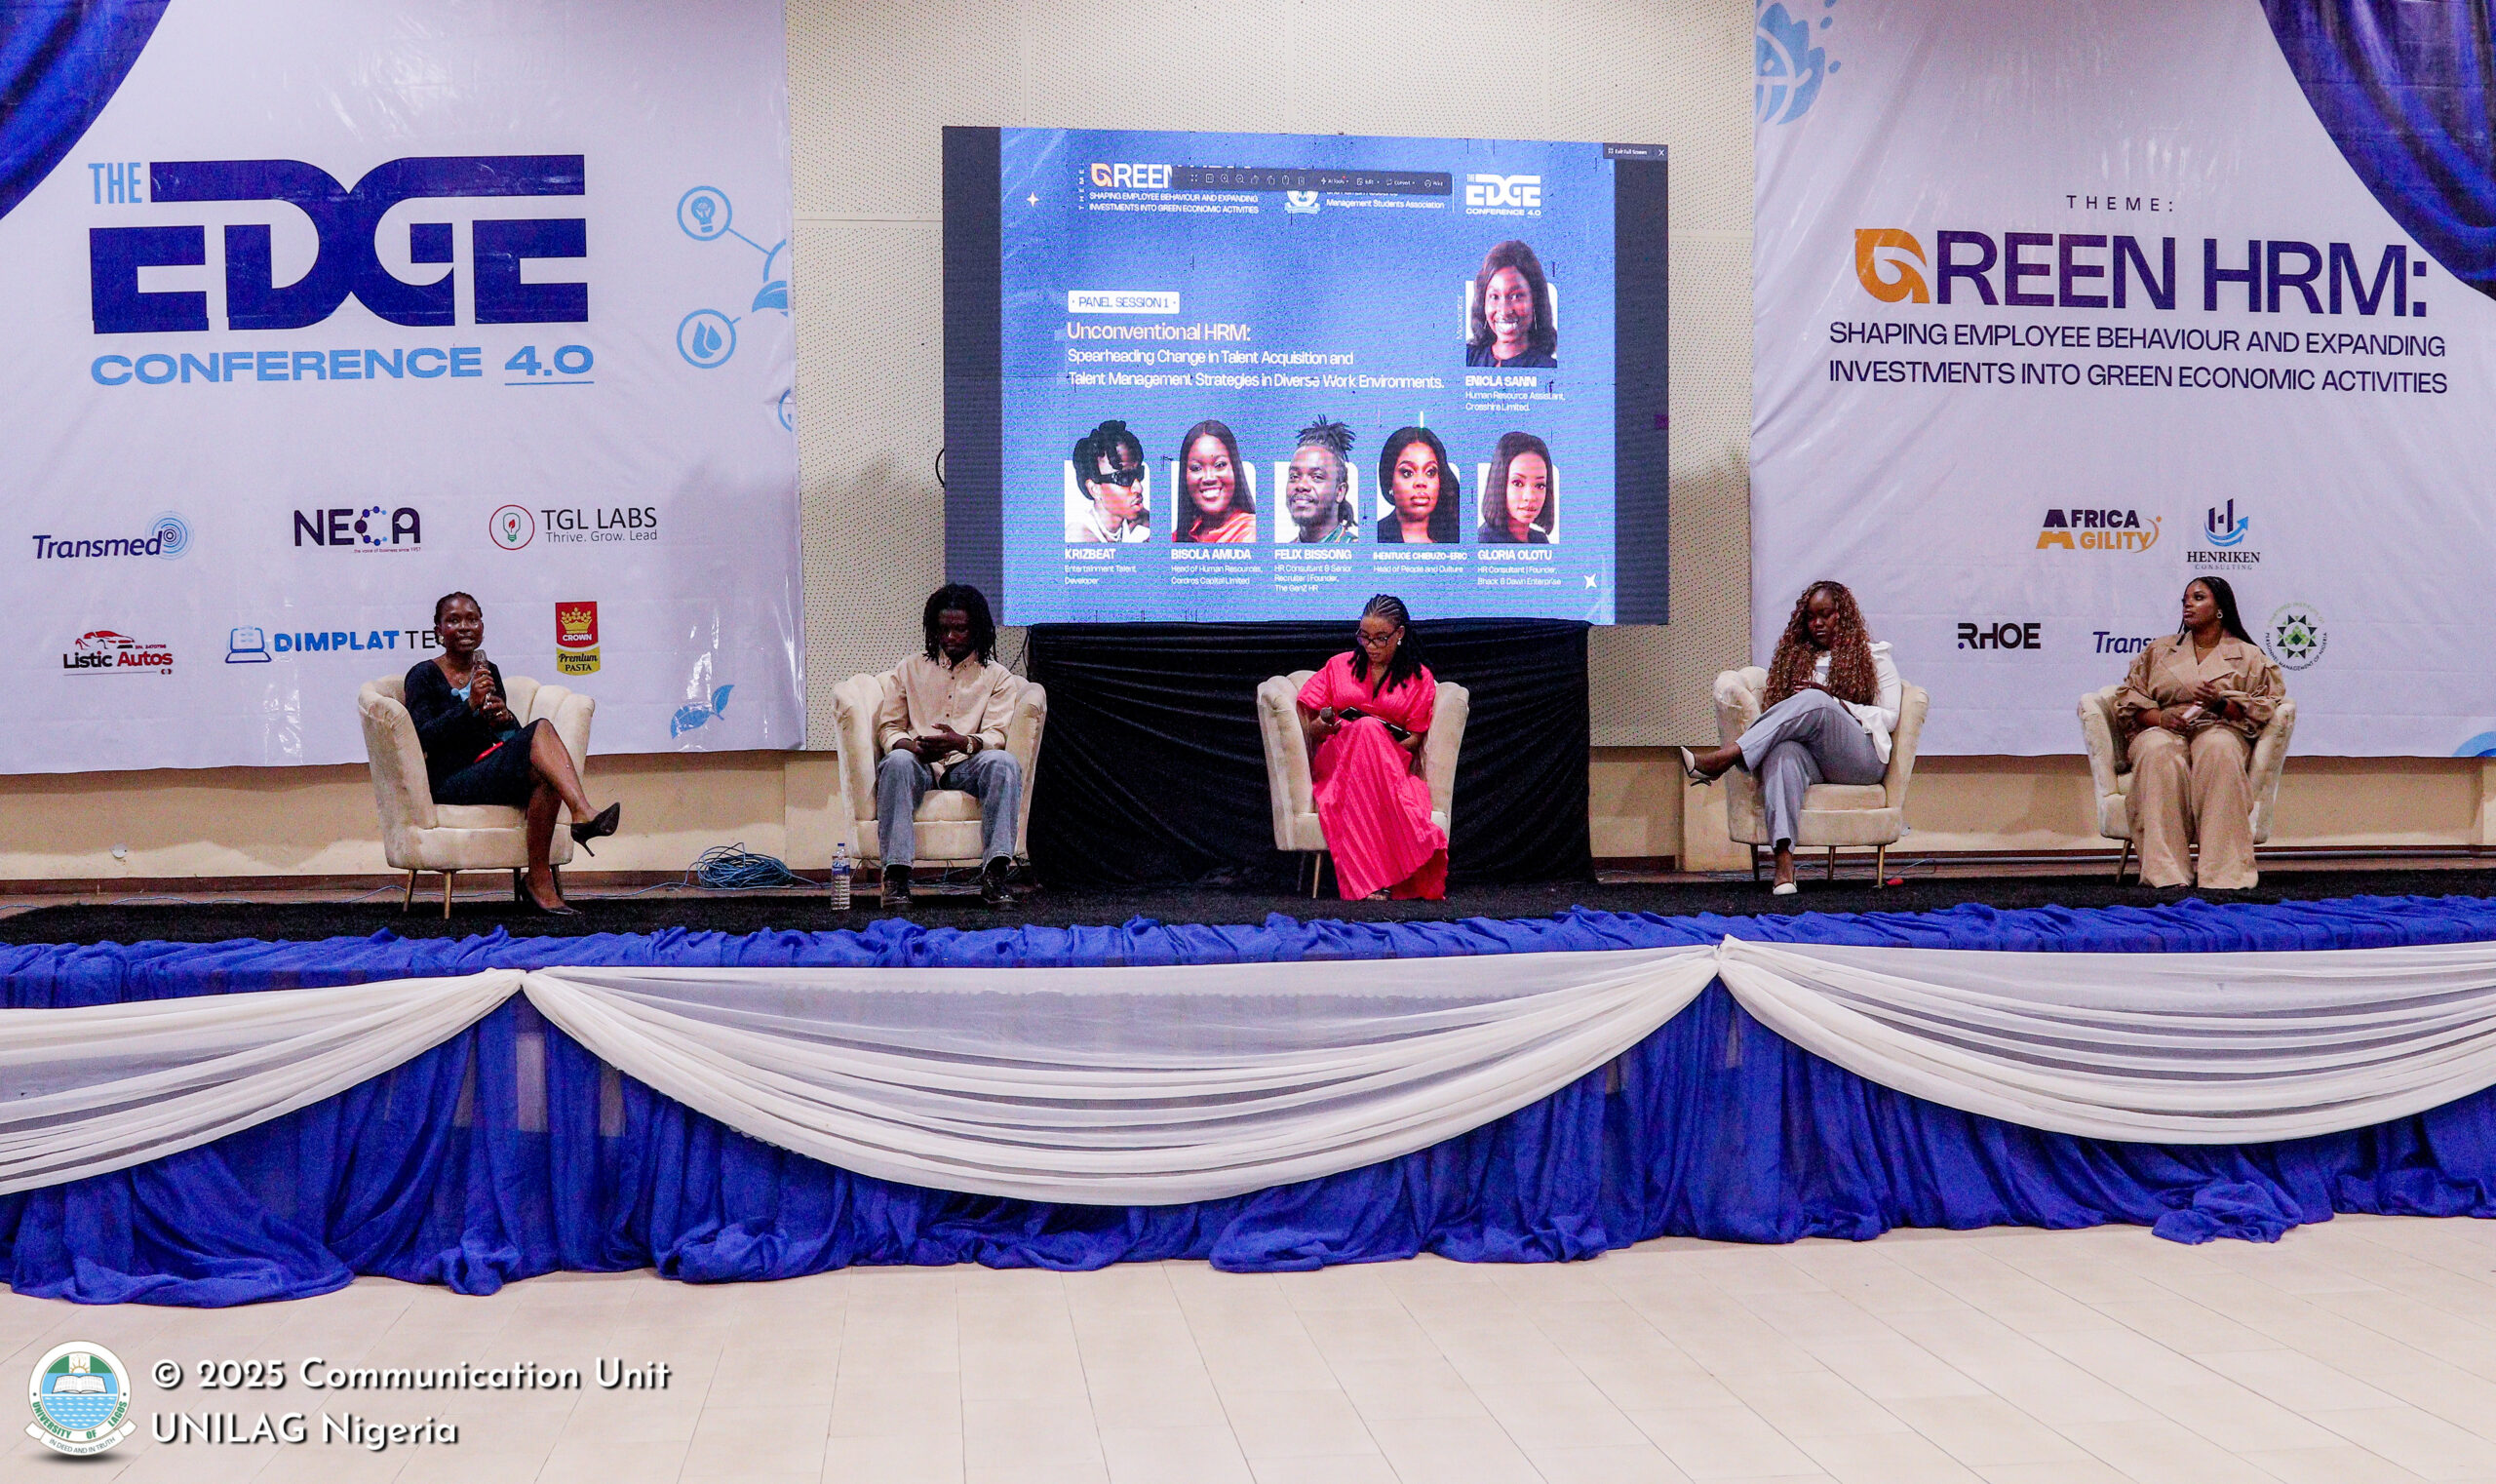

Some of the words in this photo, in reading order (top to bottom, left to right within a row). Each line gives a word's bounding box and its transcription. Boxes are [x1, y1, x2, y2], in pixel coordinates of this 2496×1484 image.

[88, 162, 142, 205] THE
[1466, 174, 1540, 207] EDGE
[1217, 194, 1259, 203] EXPANDING
[1326, 199, 1372, 209] Management
[1373, 199, 1405, 209] Students
[1405, 200, 1445, 209] Association
[1141, 203, 1157, 212] INTO
[1158, 204, 1182, 213] GREEN
[1223, 205, 1260, 214] ACTIVITIES
[90, 155, 588, 333] EDGE
[1854, 228, 2176, 310] GREEN
[2204, 238, 2427, 318] HRM:
[1078, 296, 1113, 308] PANEL
[1115, 296, 1162, 308] SESSION
[1164, 297, 1170, 308] 1
[1067, 321, 1201, 340] Unconventional
[1203, 324, 1252, 341] HRM:
[1829, 321, 1948, 345] SHAPING
[1954, 323, 2090, 347] EMPLOYEE
[2096, 327, 2241, 351] BEHAVIOUR
[2246, 331, 2300, 353] AND
[2306, 332, 2446, 357] EXPANDING
[91, 347, 482, 386] CONFERENCE
[504, 345, 594, 377] 4.0
[1068, 348, 1154, 366] Spearheading
[1156, 349, 1207, 367] Change
[1208, 350, 1219, 363] in
[1221, 349, 1259, 365] Talent
[1261, 351, 1328, 367] Acquisition
[1330, 351, 1353, 365] and
[1069, 371, 1106, 386] Talent
[1108, 372, 1192, 388] Management
[1195, 372, 1260, 389] Strategies
[1262, 373, 1272, 386] in
[1273, 374, 1320, 388] Diverse
[1322, 374, 1357, 388] Work
[1359, 374, 1445, 389] Environments.
[1503, 376, 1538, 387] SANNI
[1829, 360, 2015, 384] INVESTMENTS
[2021, 363, 2081, 386] INTO
[2086, 364, 2172, 387] GREEN
[2179, 367, 2316, 389] ECONOMIC
[2321, 370, 2448, 394] ACTIVITIES
[1464, 391, 1493, 400] Human
[1494, 391, 1529, 400] Resource
[294, 505, 421, 546] NECA
[541, 509, 589, 530] TGL
[598, 507, 657, 529] LABS
[2043, 509, 2141, 528] AFRICA
[32, 530, 163, 560] Transmed
[546, 531, 587, 543] Thrive.
[591, 530, 625, 542] Grow.
[630, 529, 657, 541] Lead
[1065, 548, 1116, 560] KRIZBEAT
[1170, 548, 1211, 560] BISOLA
[1211, 548, 1252, 560] AMUDA
[1274, 549, 1303, 560] FELIX
[1304, 549, 1352, 560] BISSONG
[1477, 550, 1516, 560] GLORIA
[1517, 550, 1552, 560] OLOTU
[2186, 551, 2261, 564] HENRIKEN
[1285, 564, 1323, 572] Consultant
[274, 630, 400, 651] DIMPLAT
[405, 630, 436, 649] TE
[2092, 632, 2156, 653] Trans
[63, 651, 113, 669] Listic
[117, 650, 174, 667] Autos
[558, 653, 598, 663] Premium
